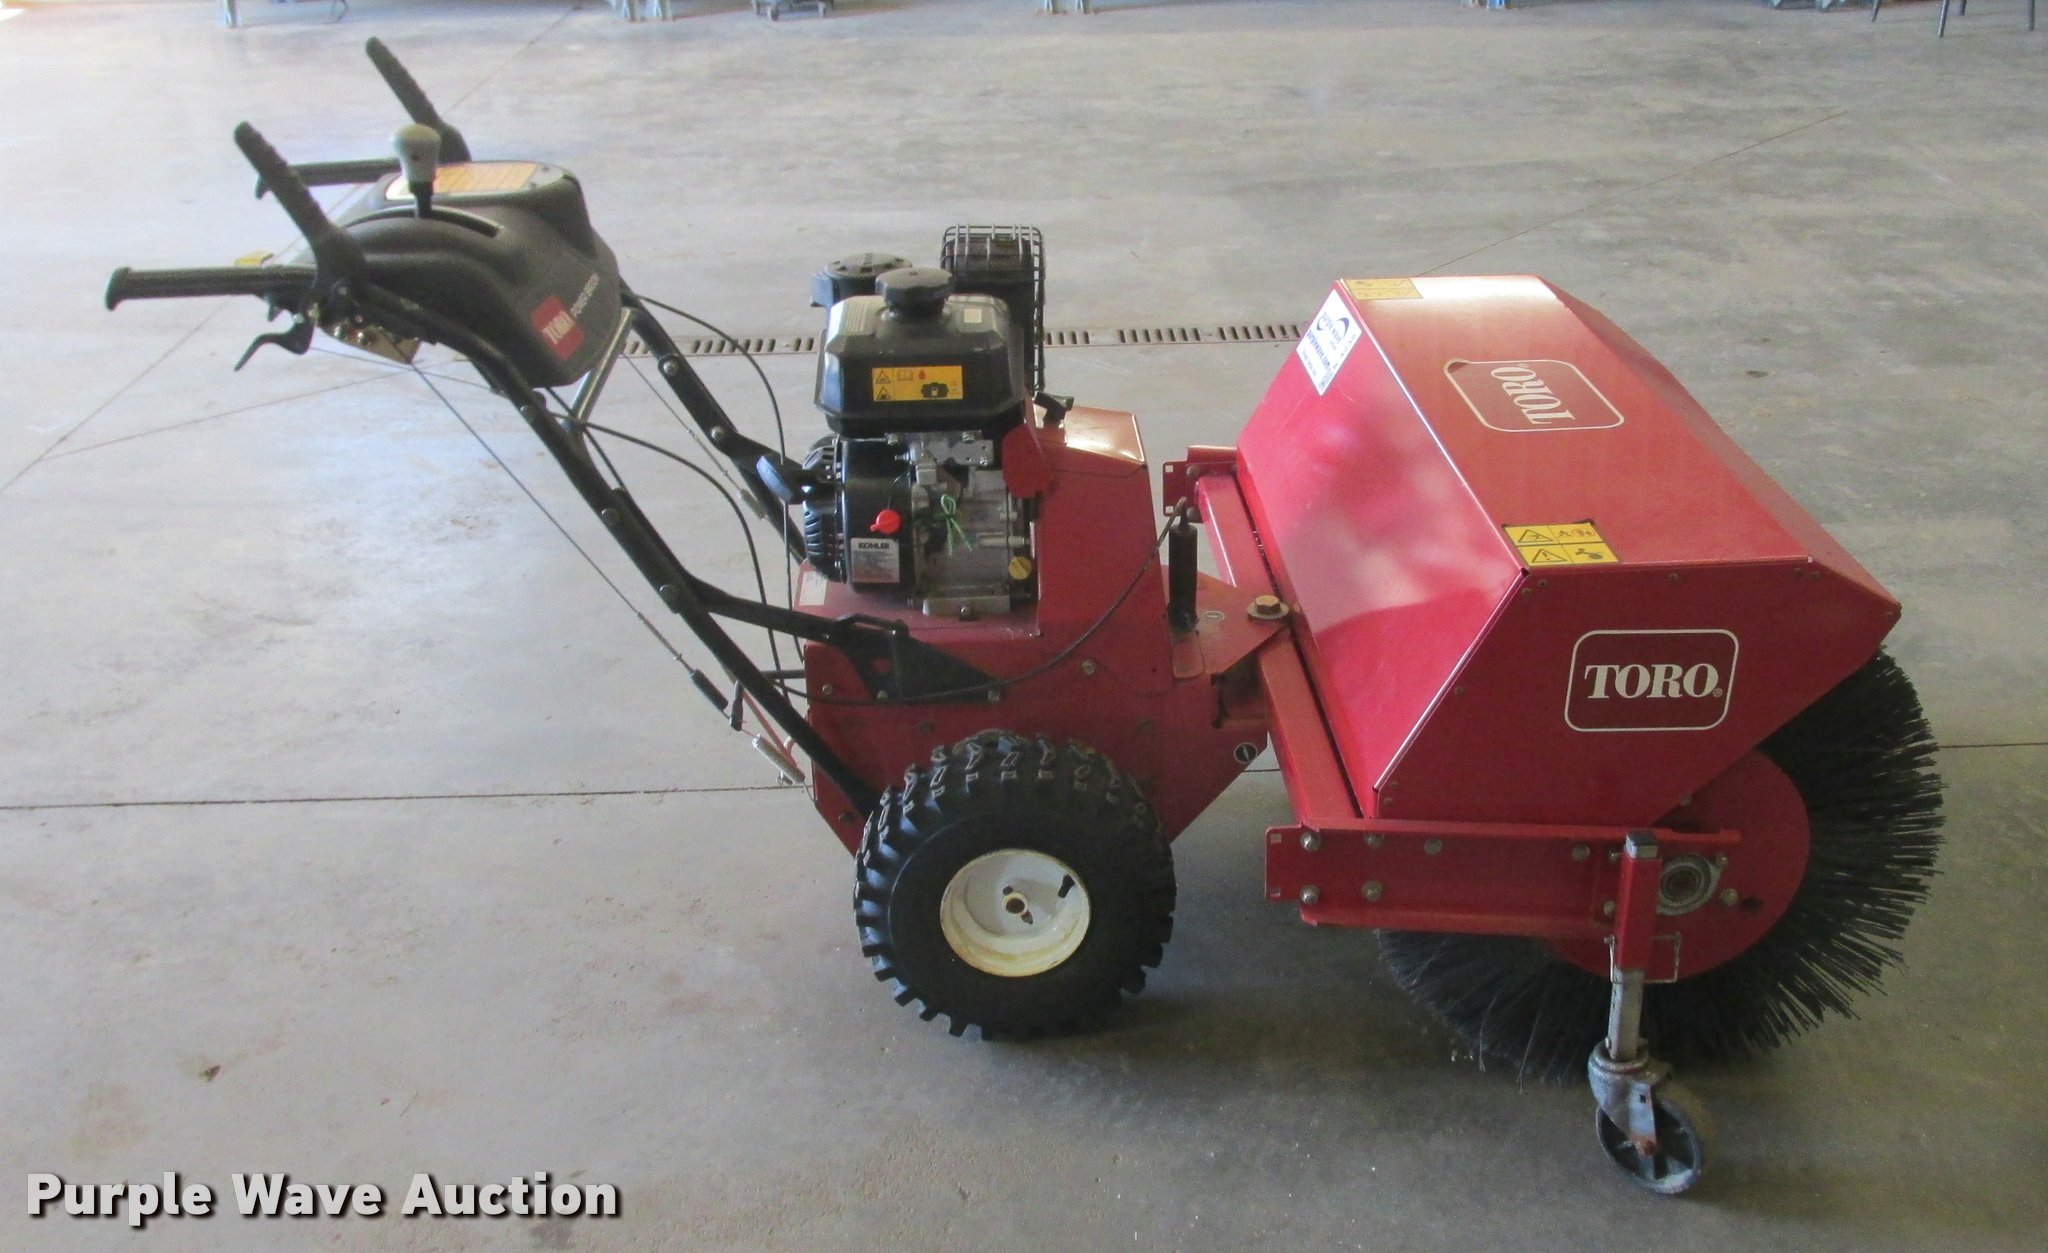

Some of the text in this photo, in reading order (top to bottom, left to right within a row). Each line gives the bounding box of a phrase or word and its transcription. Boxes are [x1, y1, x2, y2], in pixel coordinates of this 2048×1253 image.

[542, 310, 575, 345] TORO
[1490, 365, 1576, 424] TORO
[858, 542, 890, 550] KOHLER
[1584, 663, 1721, 698] TORO
